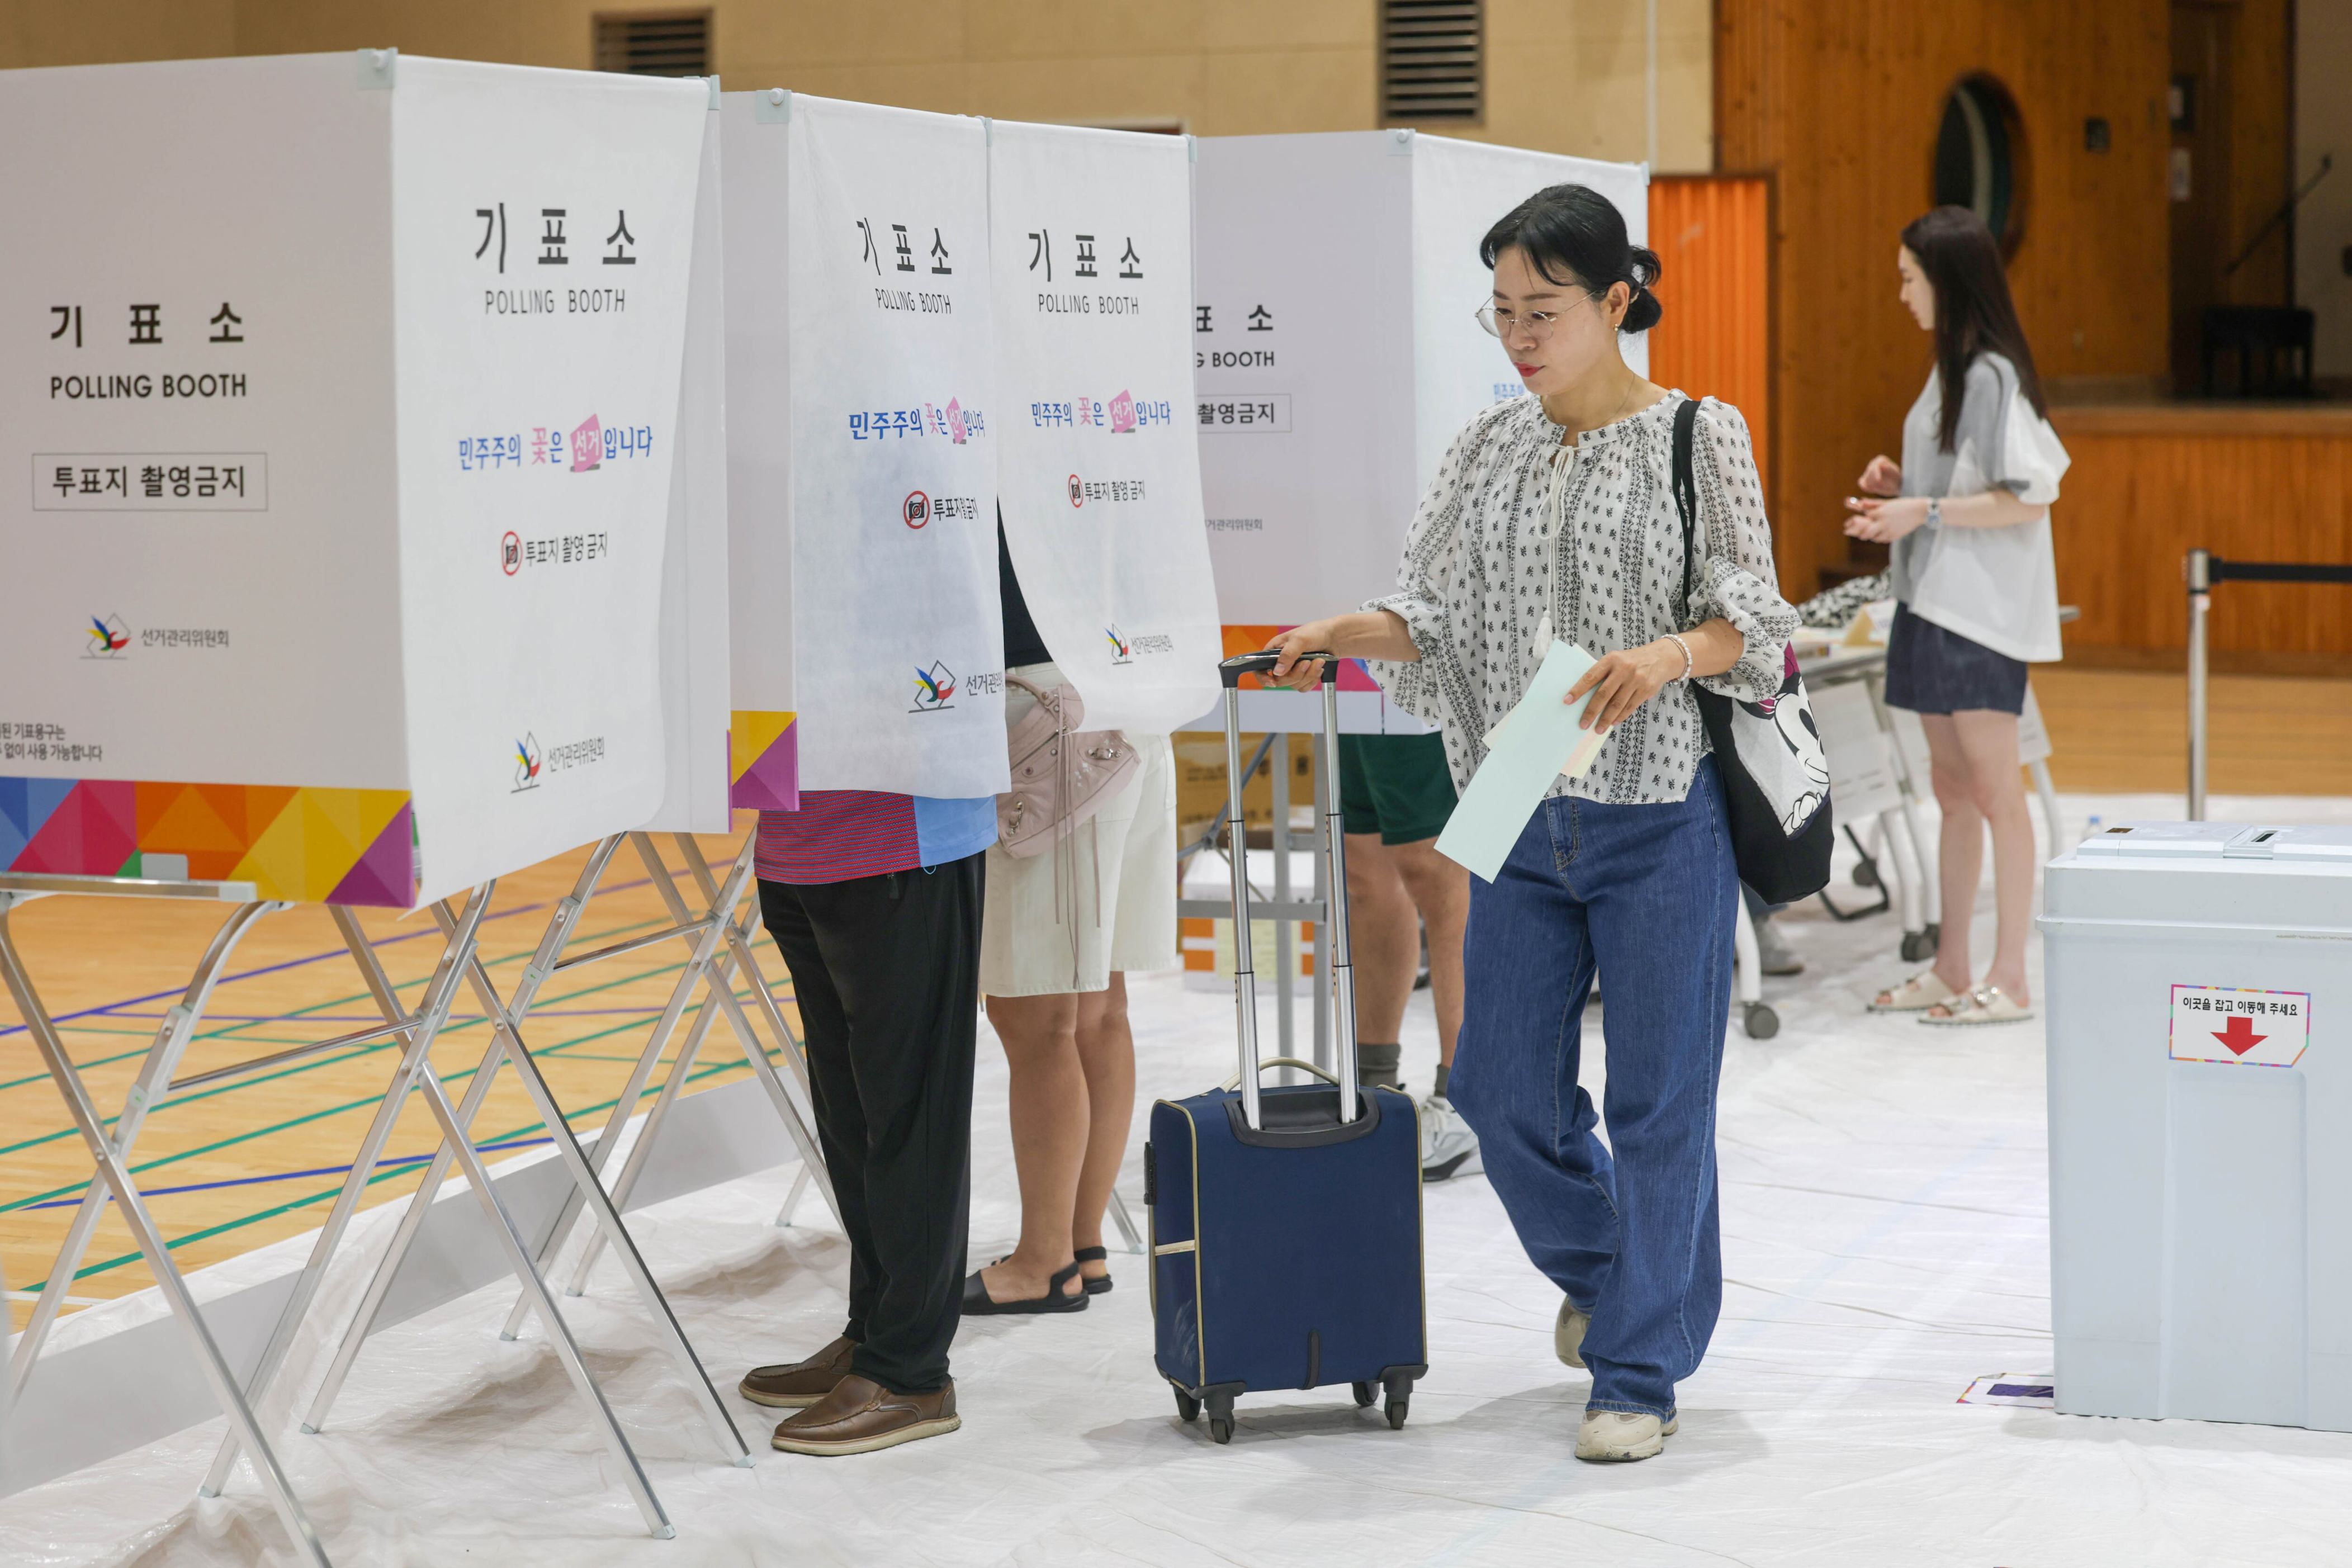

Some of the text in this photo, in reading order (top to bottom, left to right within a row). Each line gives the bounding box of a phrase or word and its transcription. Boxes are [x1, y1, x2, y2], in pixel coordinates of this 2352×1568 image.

[485, 288, 625, 314] POLLING BOOTH
[875, 288, 952, 315] POLLING BOOTH
[1038, 293, 1139, 315] POLLING BOOTH
[1212, 351, 1274, 367] BOOTH
[51, 374, 246, 399] POLLING BOOTH
[849, 409, 923, 440] 민주주의
[925, 403, 948, 435] 꽃은
[1031, 397, 1171, 428] 민주주의 꽃은 선거입니다
[1198, 402, 1274, 424] 촬영금지
[459, 426, 653, 471] 민주주의 꽃은 선거입니다
[53, 466, 244, 498] 투표지 촬영금지
[1085, 481, 1110, 502] 투표지
[1205, 518, 1262, 531] 거관리위원회
[526, 537, 558, 567] 투표지
[141, 629, 229, 647] 선거관리위원회
[548, 736, 604, 773] 선거관리위원회
[2183, 997, 2298, 1016] 이곳을 잡고 이동해 주세요
